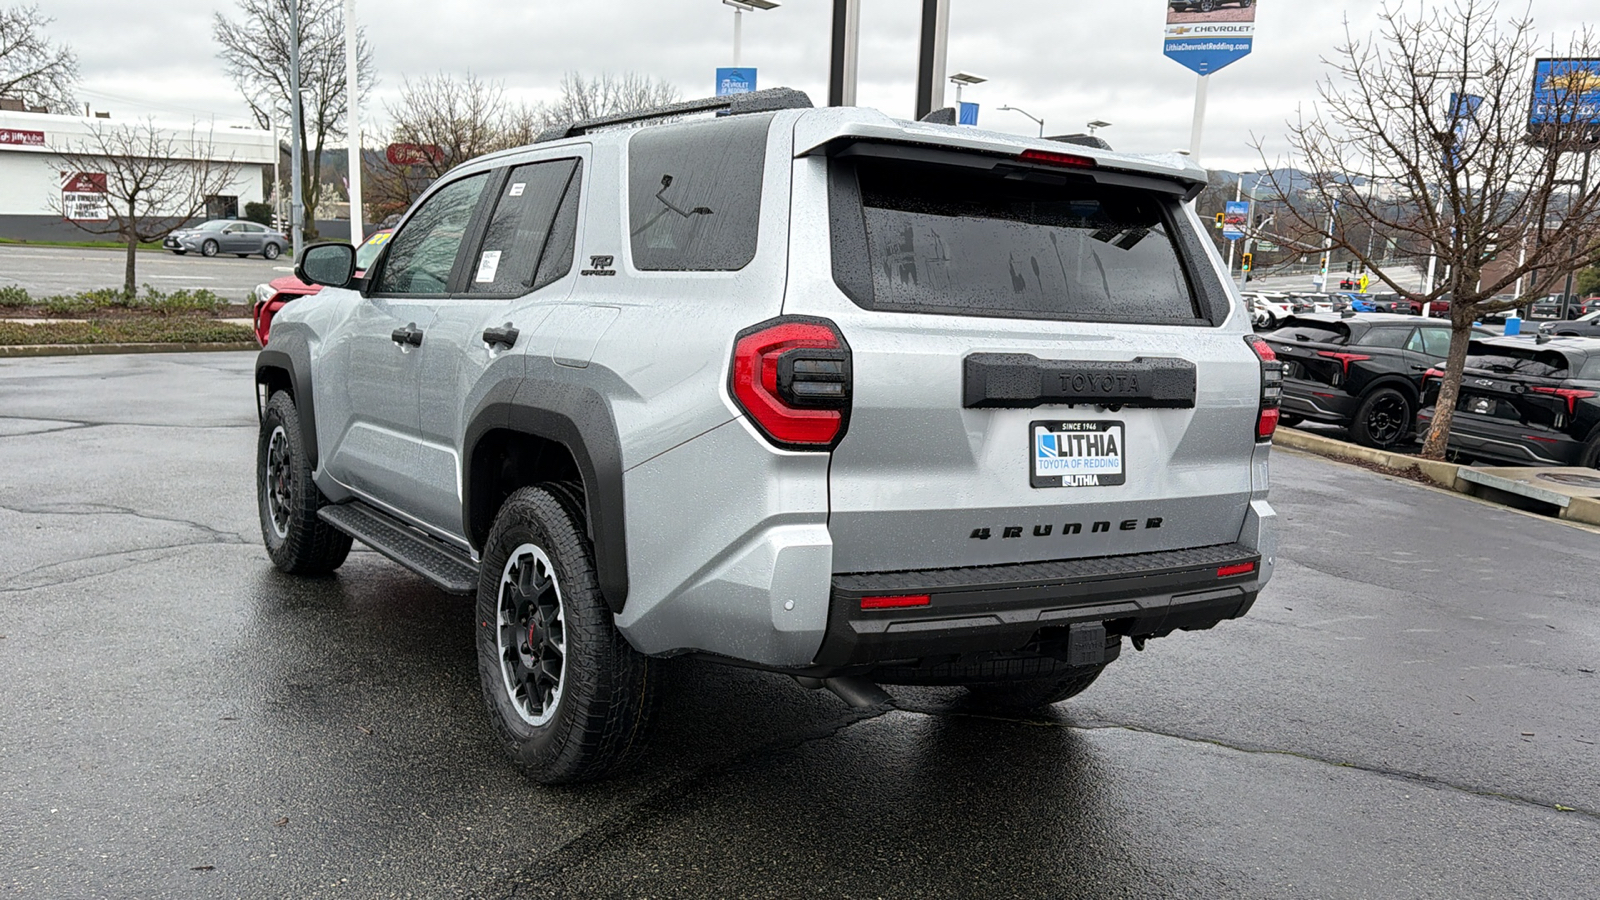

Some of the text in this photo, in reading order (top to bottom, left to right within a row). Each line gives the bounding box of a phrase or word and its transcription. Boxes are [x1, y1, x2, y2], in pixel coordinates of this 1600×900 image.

[1166, 42, 1249, 52] LithiaChevroletRedding.com
[590, 255, 614, 269] TRD
[1059, 372, 1140, 393] TOYOTA
[1057, 434, 1118, 457] LITHIA
[1039, 458, 1119, 469] TOYOTA OF REDDING
[1071, 474, 1099, 486] LITHIA
[969, 517, 1164, 540] 4RUNNER
